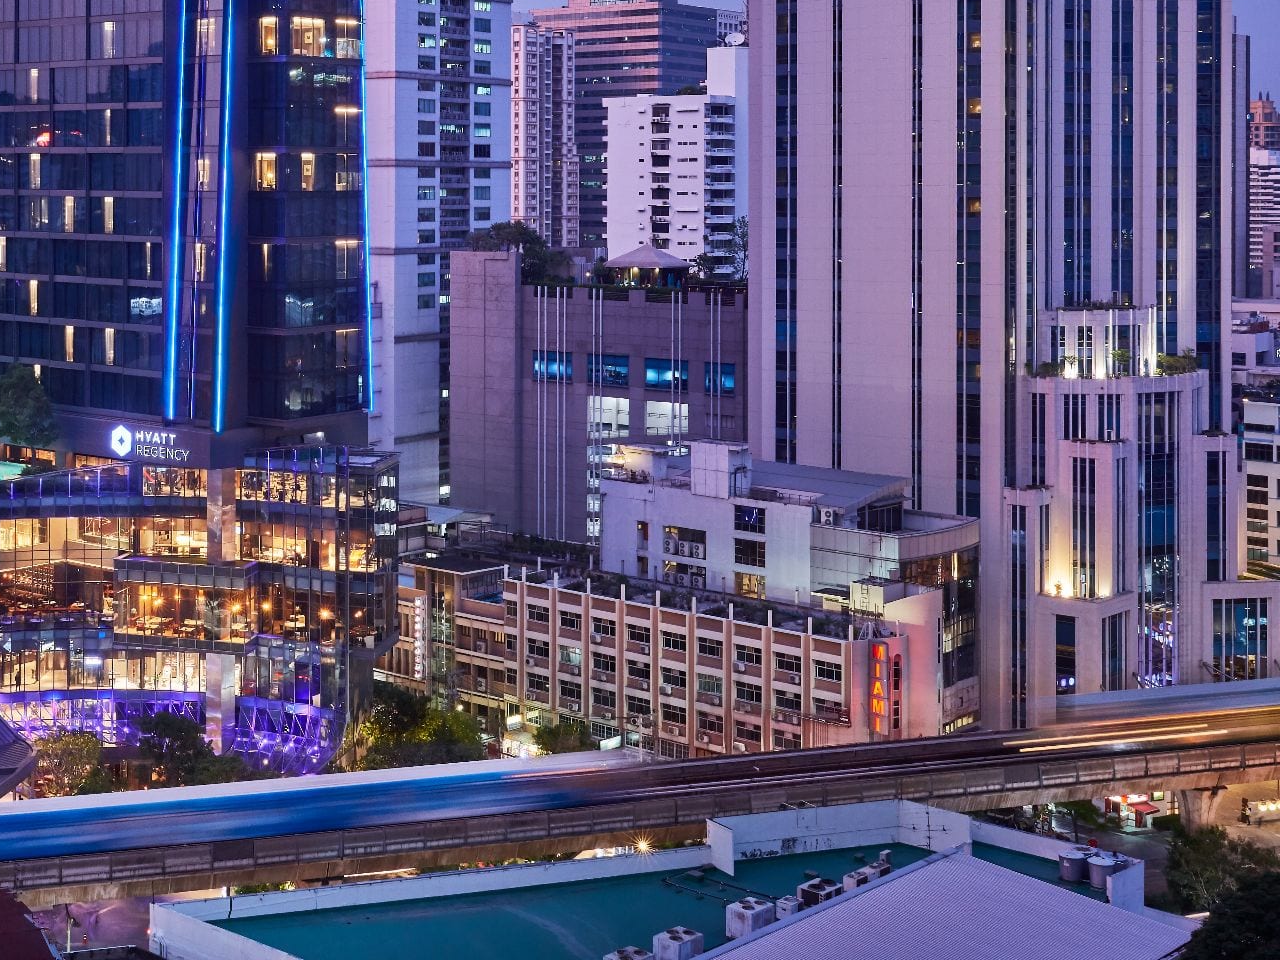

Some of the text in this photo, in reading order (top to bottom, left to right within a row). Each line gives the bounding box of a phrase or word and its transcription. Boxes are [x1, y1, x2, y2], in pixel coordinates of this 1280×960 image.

[135, 430, 177, 446] HYATT
[135, 444, 190, 462] REGENCY
[871, 643, 885, 733] MIAMI
